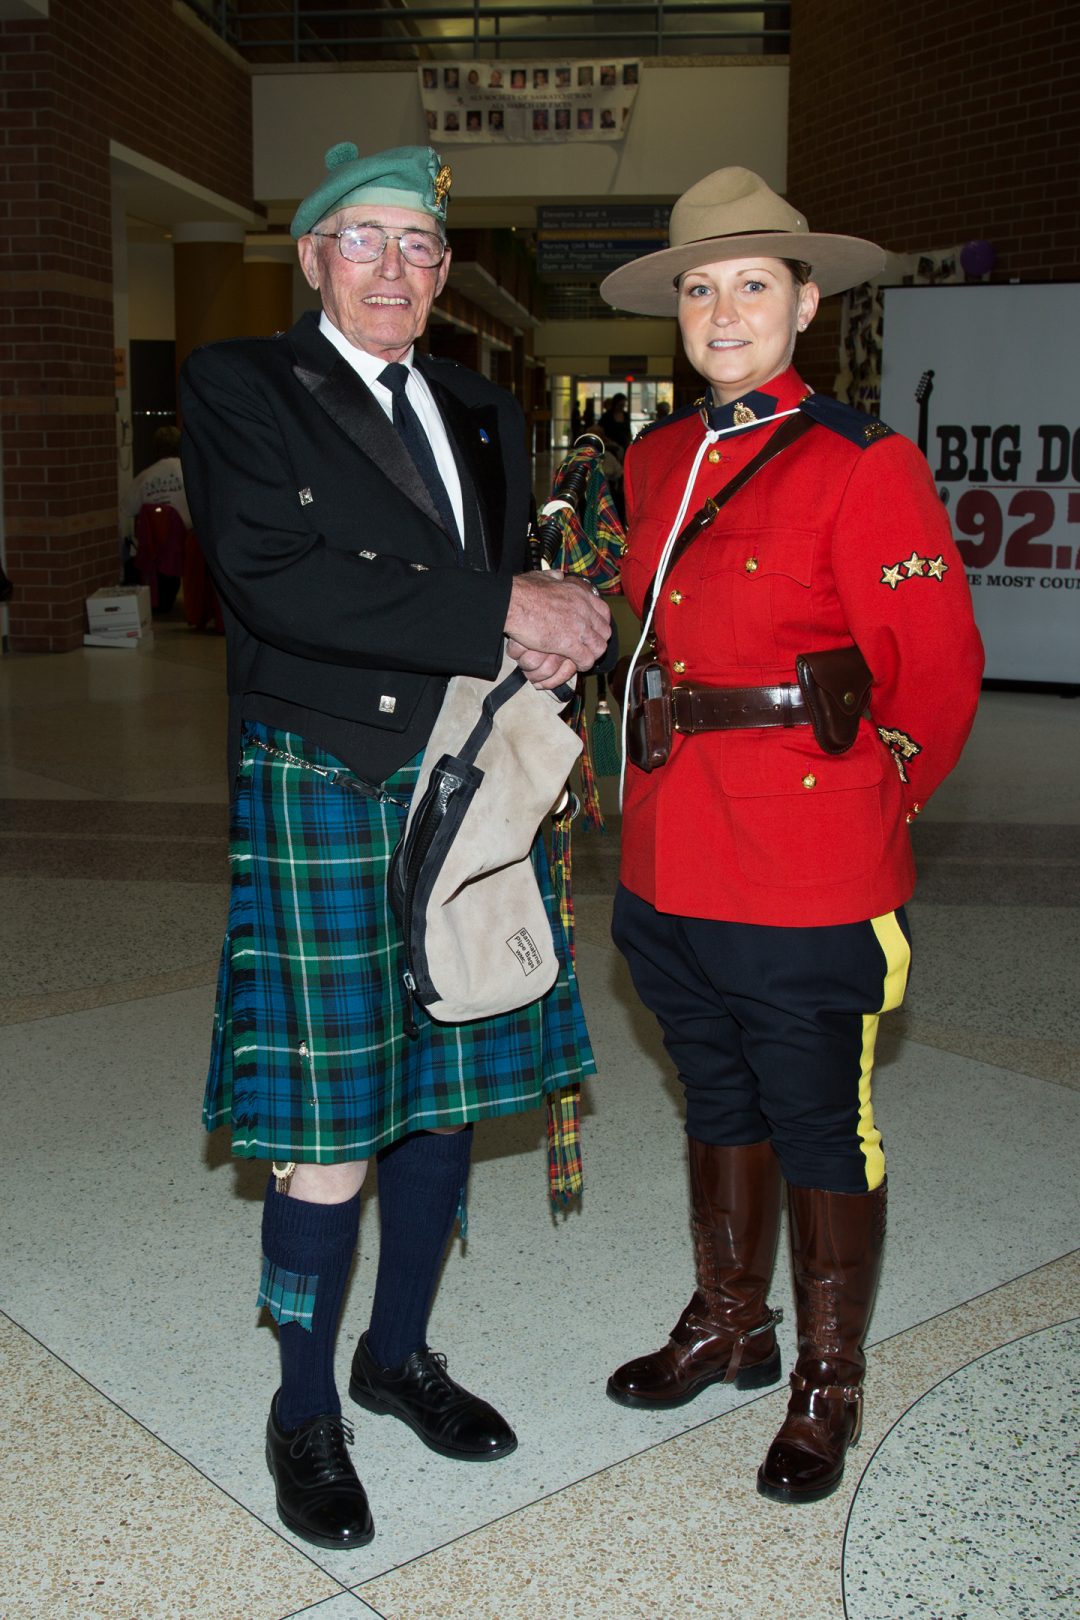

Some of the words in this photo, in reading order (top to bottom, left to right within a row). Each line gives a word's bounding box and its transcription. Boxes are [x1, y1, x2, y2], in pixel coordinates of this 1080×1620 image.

[611, 220, 652, 228] Information
[542, 242, 569, 250] Nursing
[569, 252, 599, 260] Program
[542, 263, 559, 271] Gym
[935, 425, 1021, 482] BIG
[1036, 425, 1080, 482] D
[955, 490, 1080, 570] 92.
[987, 575, 1035, 588] MOST
[514, 936, 527, 951] Pipe
[525, 951, 535, 969] Bags
[520, 930, 541, 964] Bannatyne
